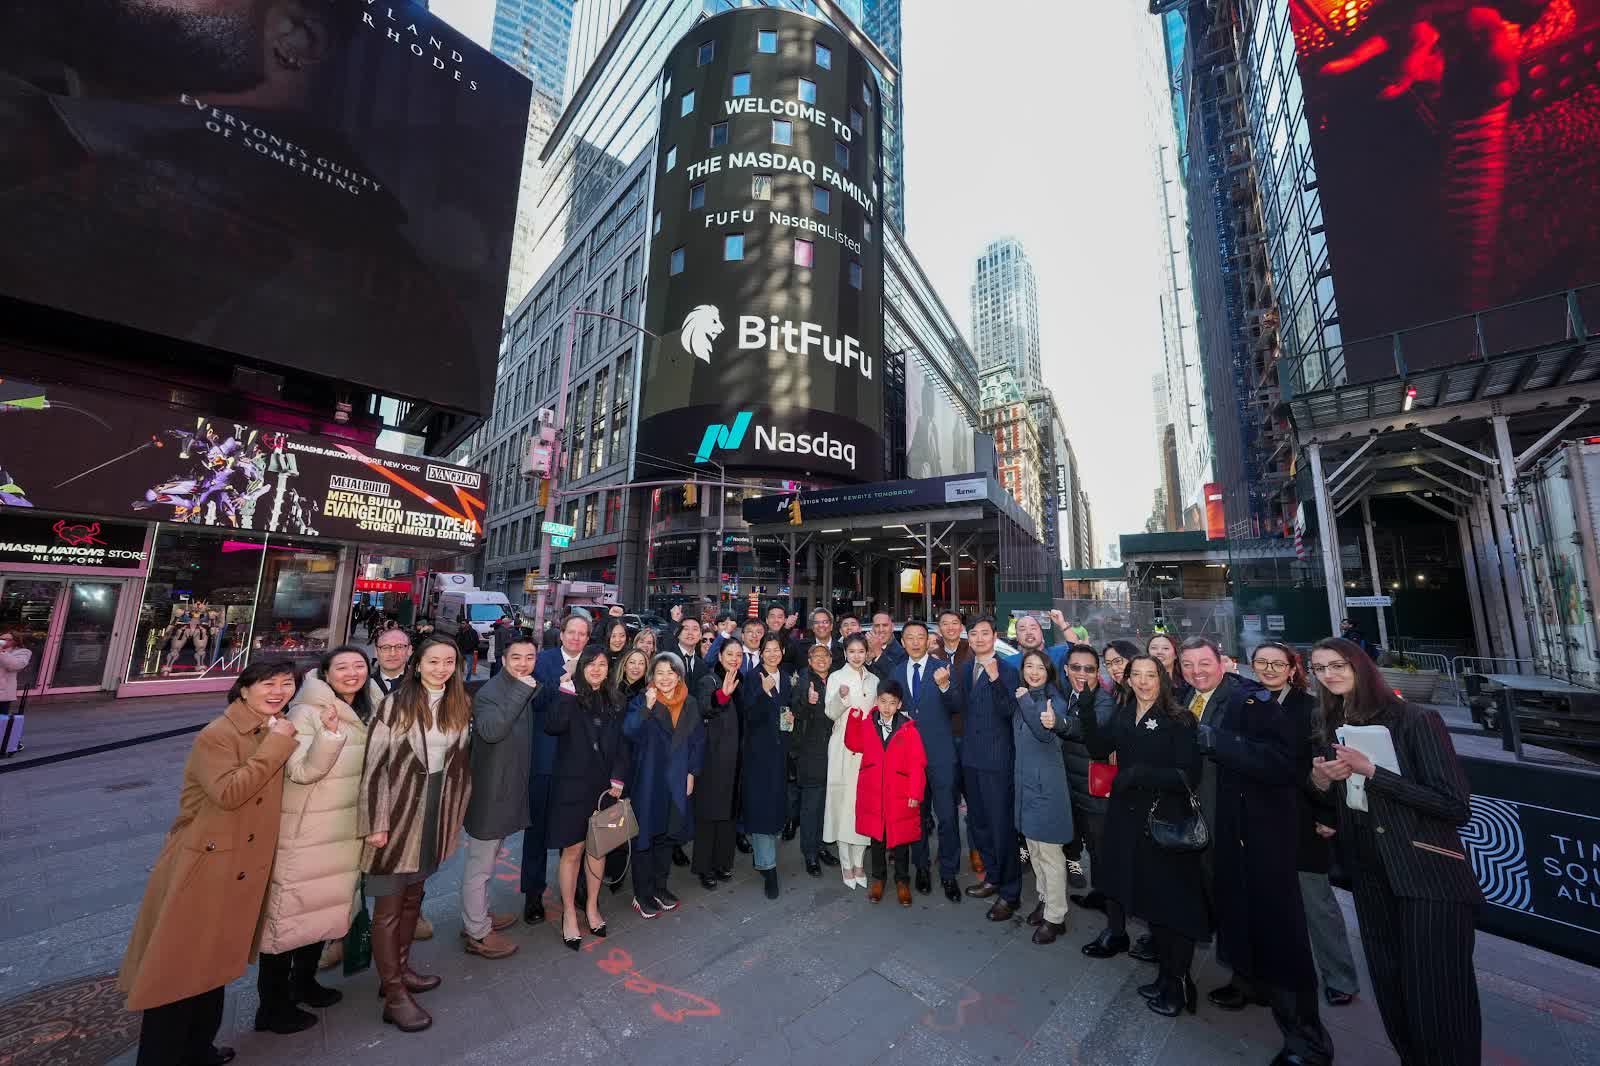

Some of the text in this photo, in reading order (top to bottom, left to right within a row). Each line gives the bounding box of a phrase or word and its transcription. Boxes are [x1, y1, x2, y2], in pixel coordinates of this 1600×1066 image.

[362, 11, 478, 91] RHODES
[725, 98, 852, 142] WELCOME TO
[180, 93, 382, 192] EVERYONE'S GUILTY
[206, 121, 360, 195] OF SOMETHING
[686, 151, 874, 217] THE NASDAQ FAMILY!
[705, 209, 755, 228] FUFU
[738, 315, 872, 380] BitFuFu
[754, 425, 856, 470] Nasdaq
[358, 455, 382, 466] STORE
[383, 459, 401, 469] NEW
[401, 463, 421, 474] YORK
[429, 467, 479, 487] EVANGELION
[327, 489, 401, 509] METAL BUILD
[874, 489, 913, 498] TOMORROW
[323, 500, 477, 535] EVANGELION TEST TYPE-01
[396, 524, 436, 538] LIMITED
[32, 554, 103, 564] NEW YORK
[47, 546, 105, 556] NATIONS
[108, 550, 147, 561] STORE
